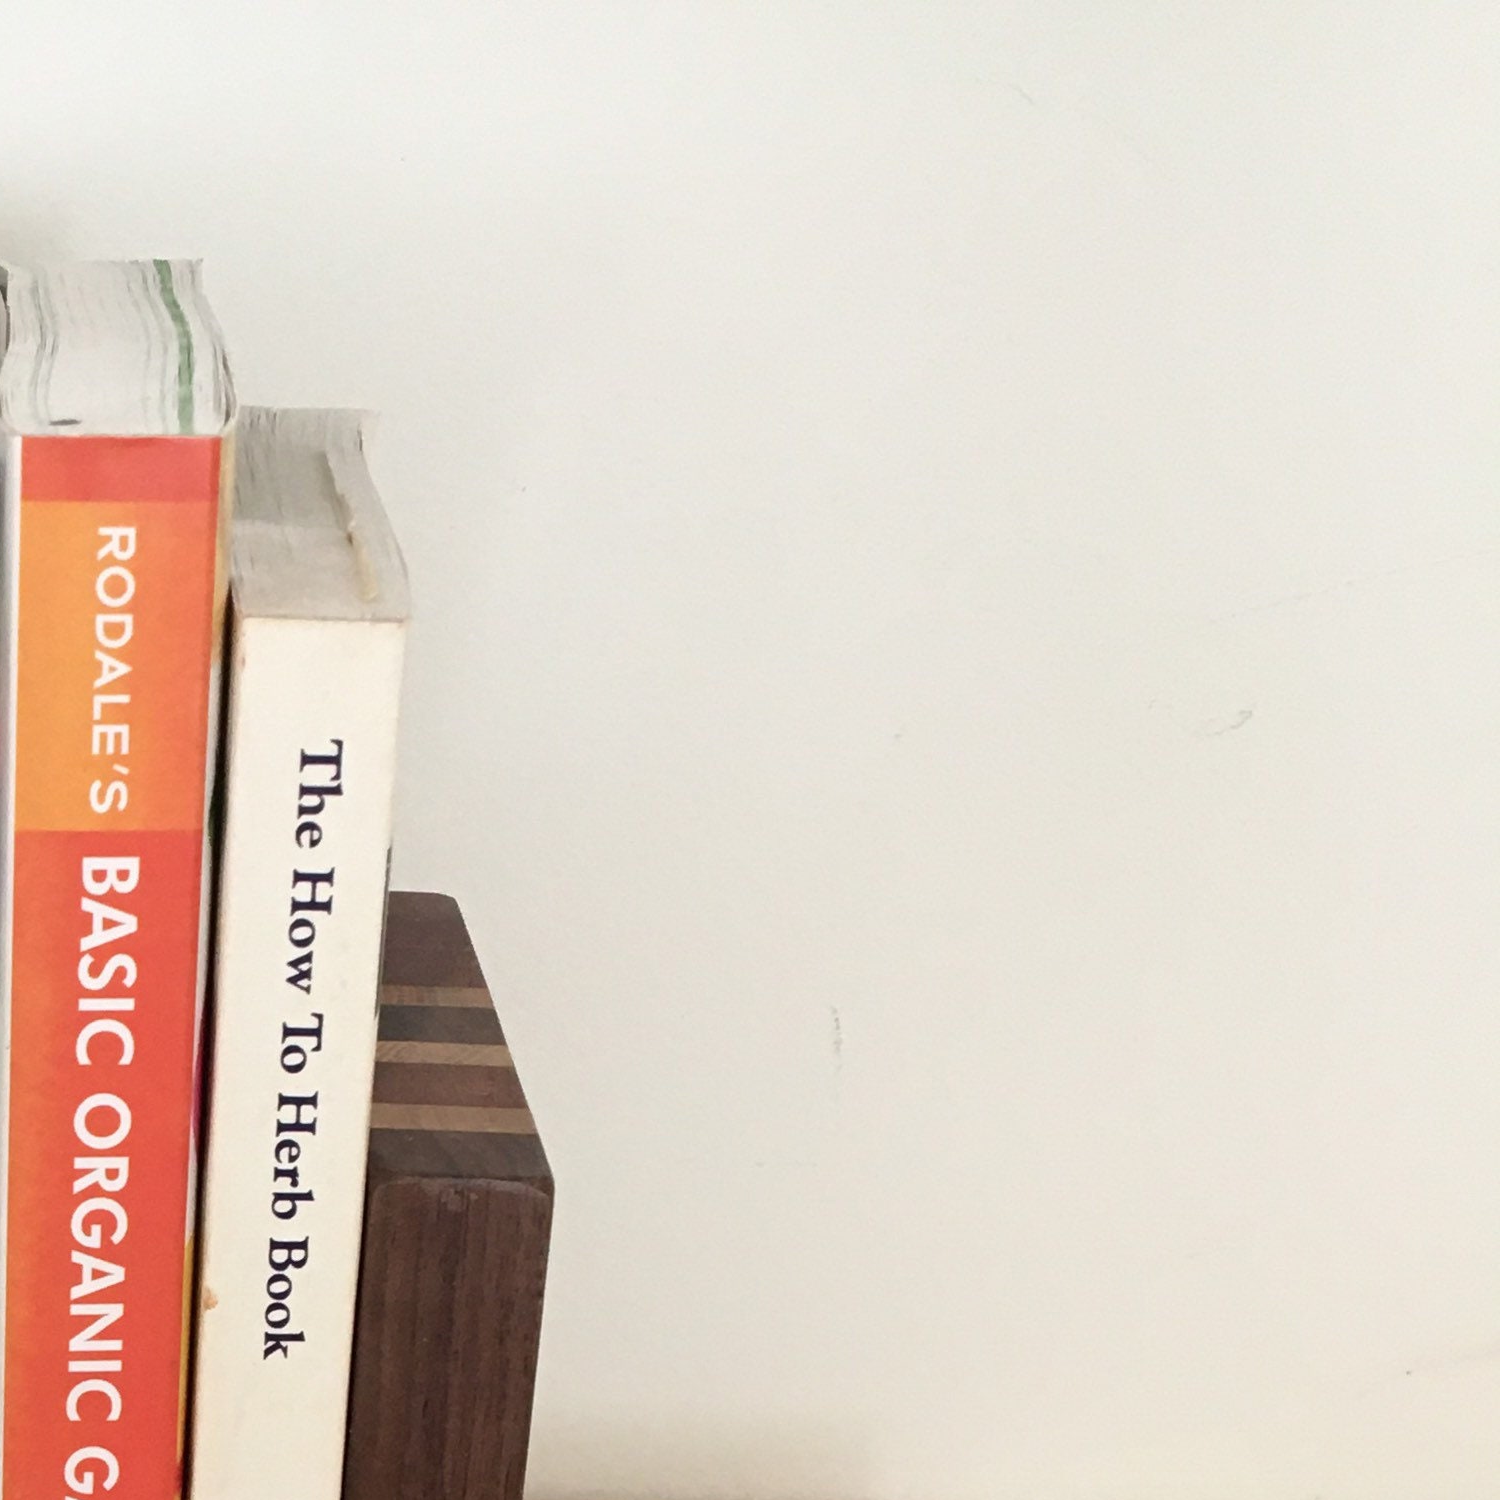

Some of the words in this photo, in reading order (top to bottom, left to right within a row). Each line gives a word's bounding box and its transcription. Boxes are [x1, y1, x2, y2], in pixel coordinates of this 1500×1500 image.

[89, 526, 137, 814] RODALE'S
[295, 739, 344, 850] The
[75, 856, 140, 1066] BASIC
[285, 867, 335, 994] How
[280, 1013, 324, 1074] To
[271, 1091, 318, 1220] Herb
[66, 1093, 132, 1422] ORGANIC
[263, 1236, 309, 1360] Book
